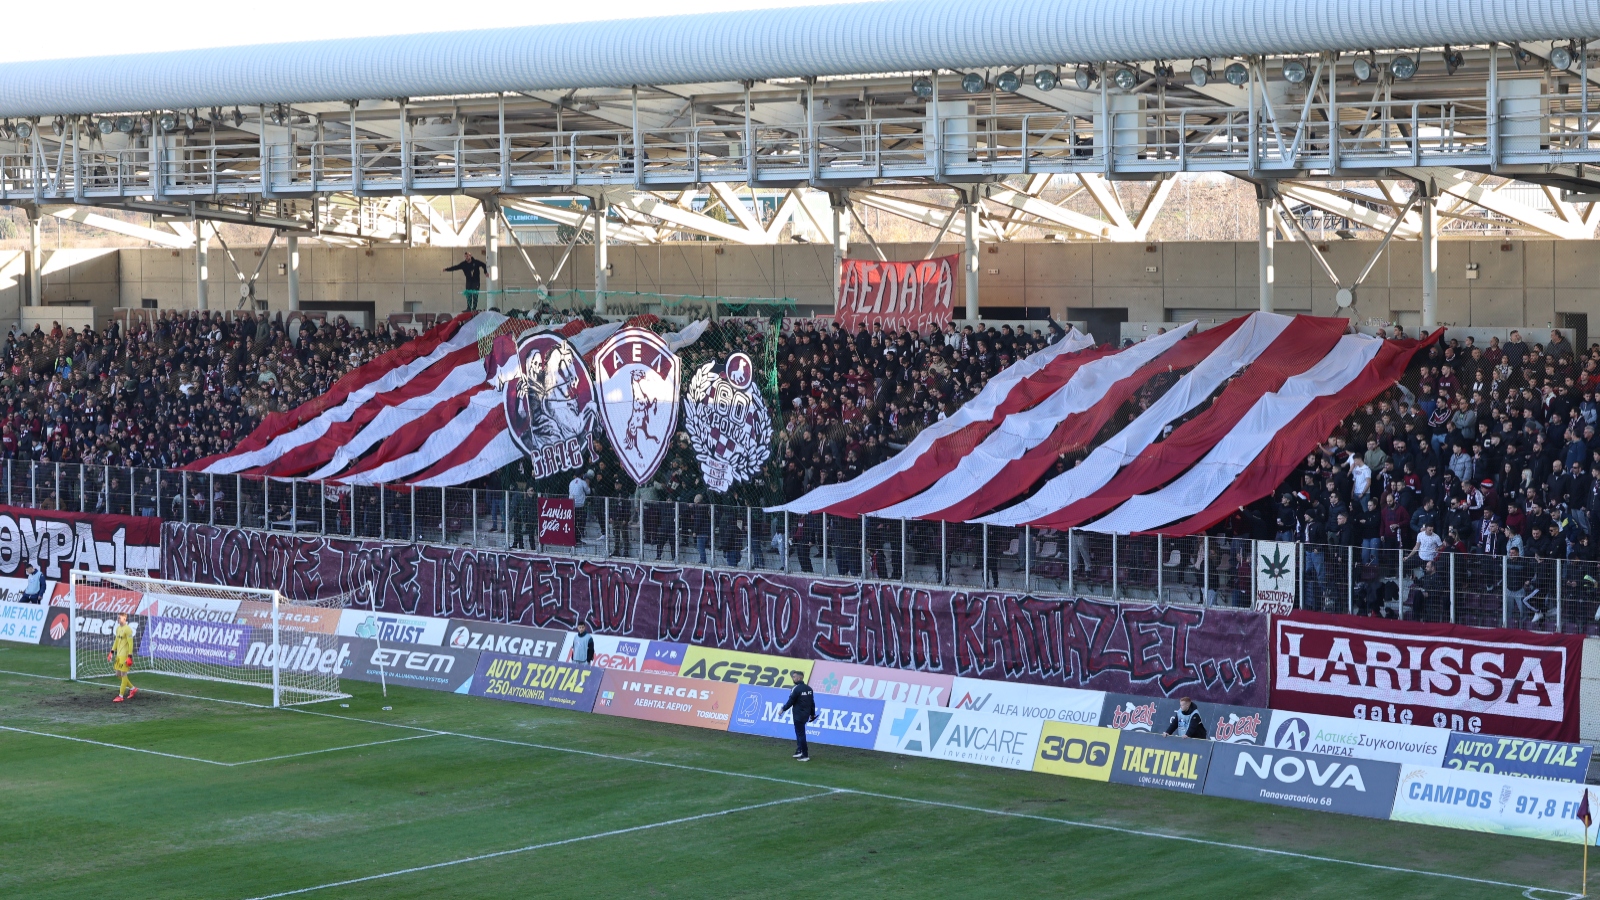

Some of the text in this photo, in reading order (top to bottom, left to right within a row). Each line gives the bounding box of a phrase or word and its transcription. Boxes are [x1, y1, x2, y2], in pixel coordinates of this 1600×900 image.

[531, 437, 583, 479] GATE
[541, 500, 572, 520] Larissa
[377, 617, 425, 644] TRUST
[651, 567, 691, 642] ΤΟ
[809, 581, 942, 671] ΞΑΝΑ
[152, 622, 244, 647] ΑΒΡΑΜΟΥΛΗΣ
[468, 631, 558, 659] ZAKCRET
[244, 636, 350, 675] novibet
[370, 648, 455, 673] ETEM
[1284, 631, 1552, 707] LARISSA
[366, 669, 388, 677] EXPERS
[486, 659, 591, 693] AUTO ΤΣΟΓΙΑΣ
[486, 679, 545, 700] 250 ΑΥΤΟΚΙΝΗΤΑ
[622, 680, 708, 700] INTERGAS
[838, 676, 944, 707] RUBIK
[634, 697, 693, 713] ΛΕΒΗΤΑΣ ΑΕΡΙΟΥ
[761, 701, 875, 735] MAAKAS
[992, 703, 1097, 723] ALFA WOOD GROUP
[1353, 703, 1482, 733] gate one
[946, 724, 1028, 756] AVCARE
[1453, 738, 1584, 767] AUTO ΤΣΟΓΙΑΣ
[943, 749, 1021, 766] inventive life
[1121, 745, 1199, 780] TACTICAL
[1234, 751, 1366, 792] NOVA
[1164, 780, 1196, 790] EQUIPMENT
[1320, 796, 1332, 806] 68
[1408, 781, 1493, 809] CAMPOS
[1516, 795, 1557, 819] 97,8
